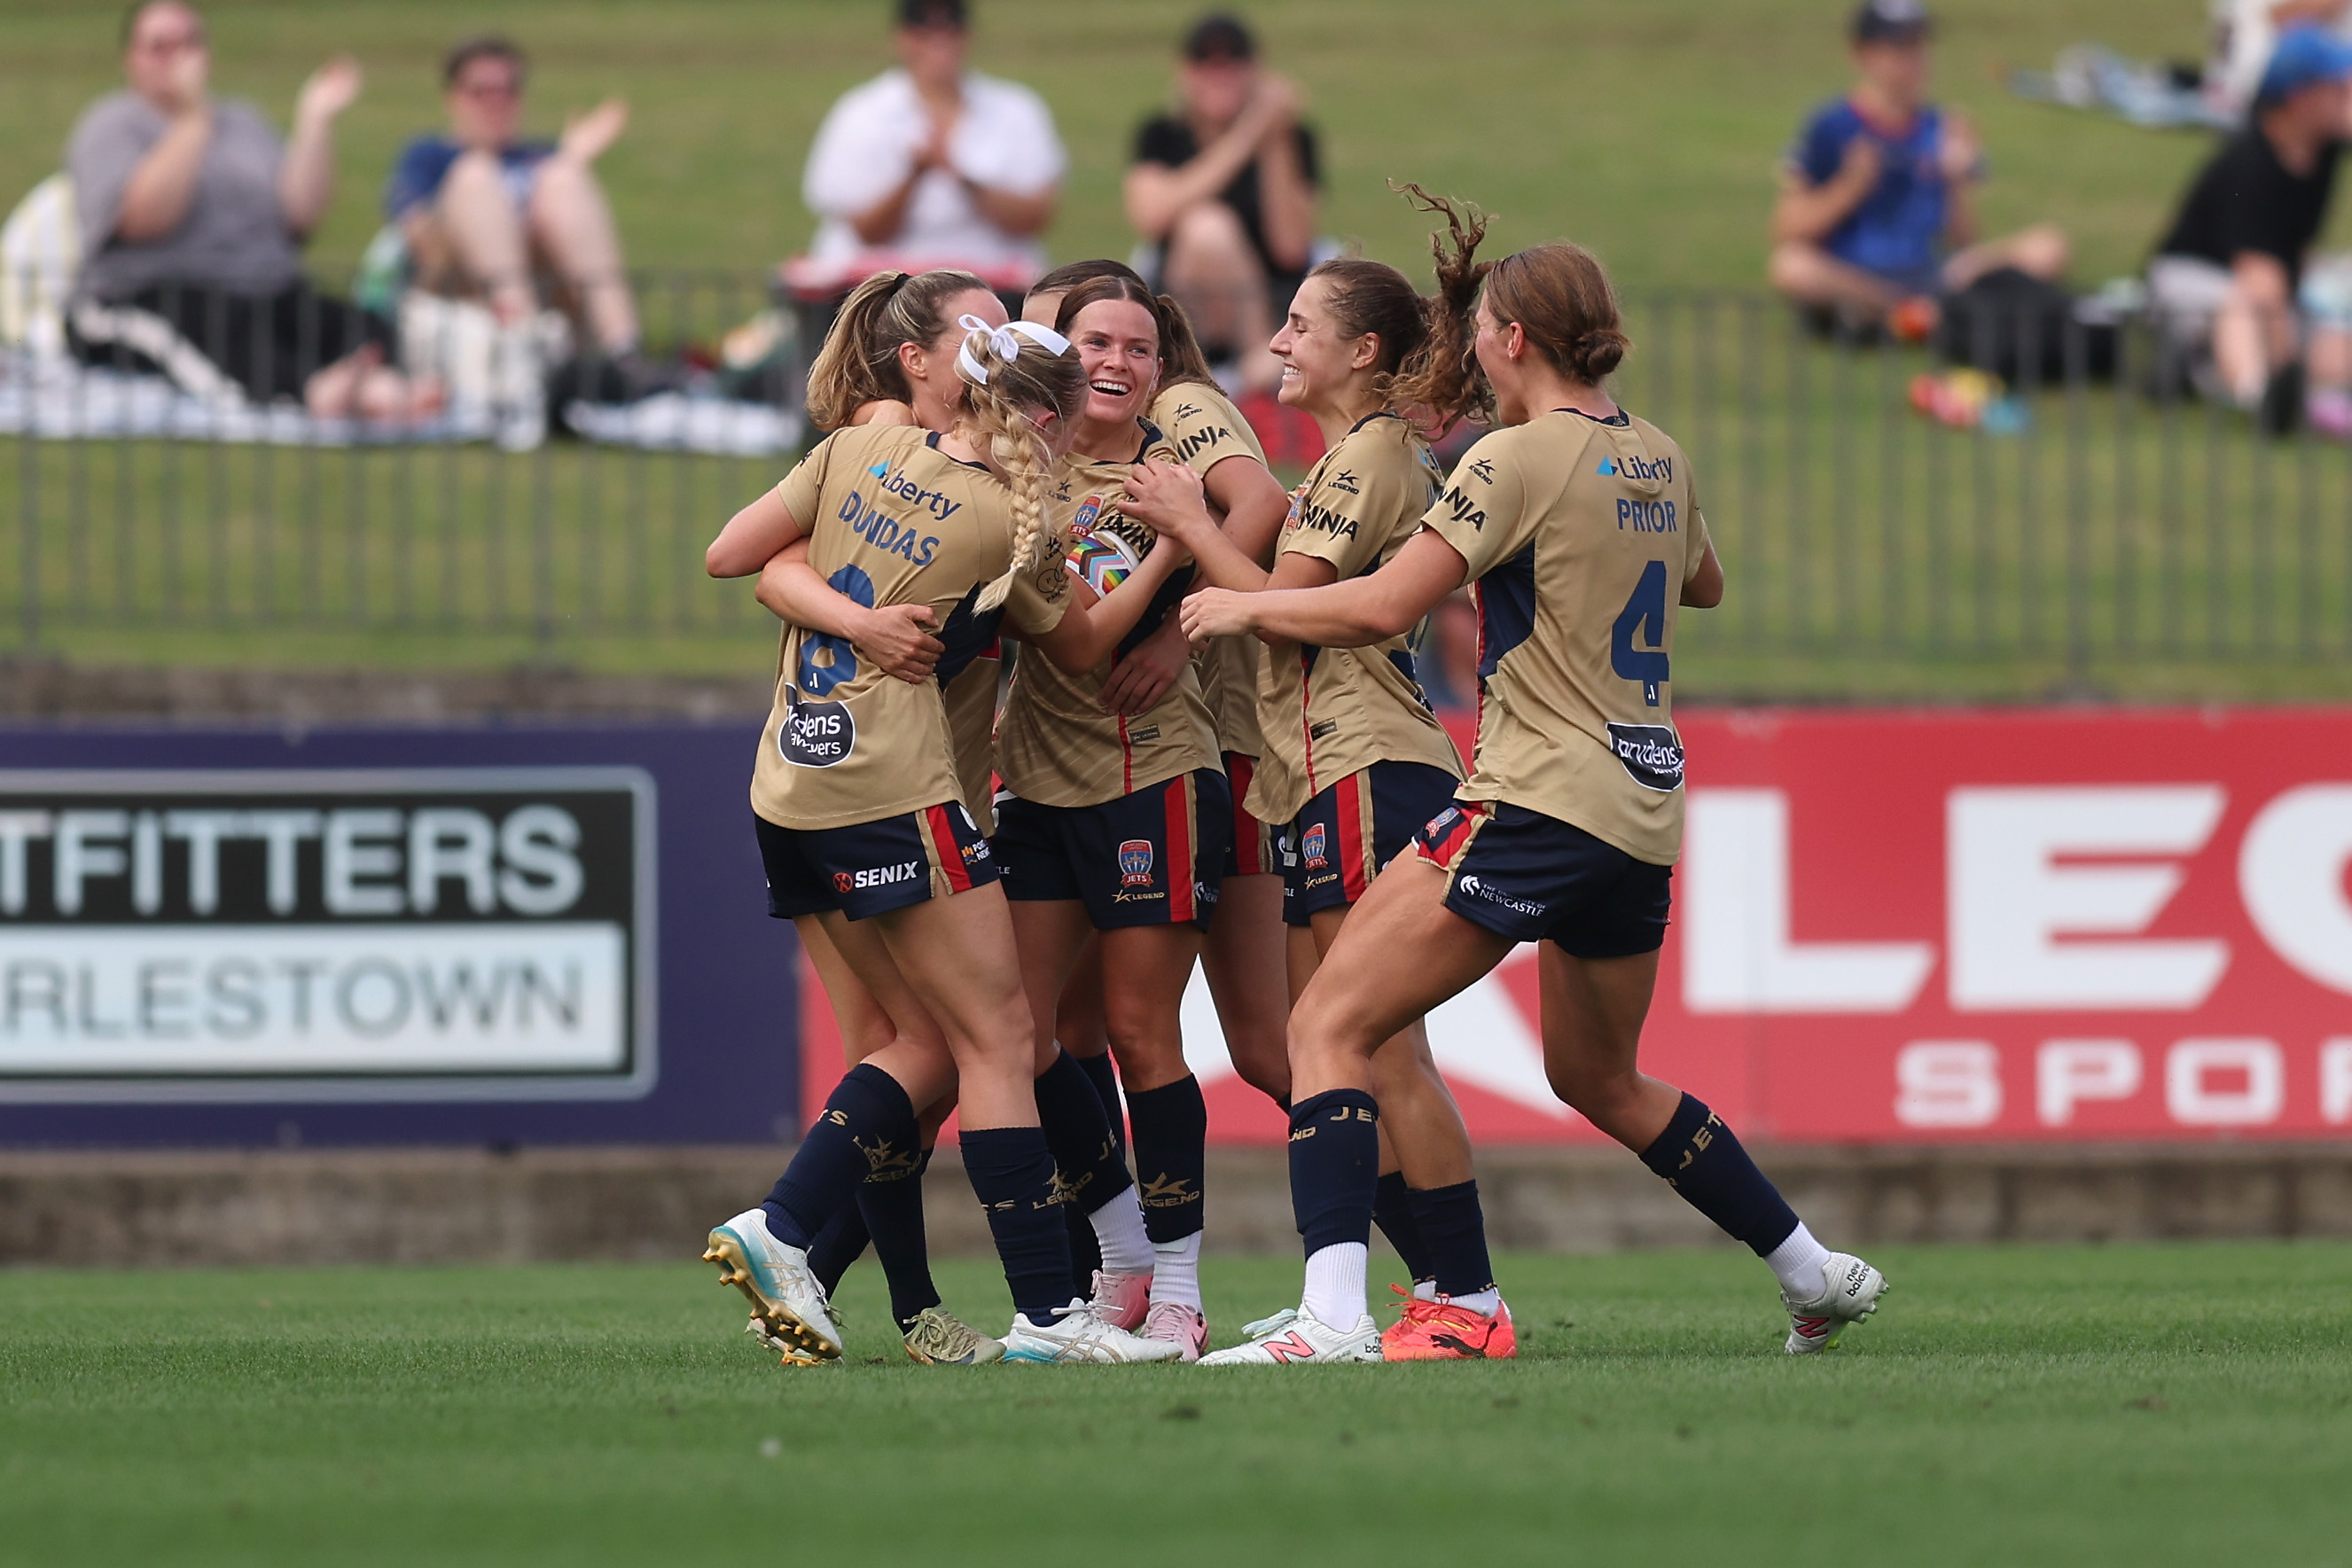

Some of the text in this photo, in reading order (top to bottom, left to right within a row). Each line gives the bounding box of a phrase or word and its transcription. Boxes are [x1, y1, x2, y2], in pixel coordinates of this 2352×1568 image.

[1328, 482, 1360, 495] LEGEND
[1442, 486, 1489, 533] NJA
[1616, 498, 1677, 534] PRIOR
[838, 490, 941, 566] DUNDAS
[1610, 560, 1670, 707] 4
[855, 861, 918, 889] SENIX
[1126, 874, 1147, 883] JETS
[1132, 892, 1165, 901] LEGEND
[1480, 889, 1545, 917] NEWCASTLE
[1678, 1111, 1723, 1170] JET
[1142, 1190, 1200, 1207] EGEND
[1845, 1263, 1871, 1298] balanc
[1847, 1262, 1861, 1283] new
